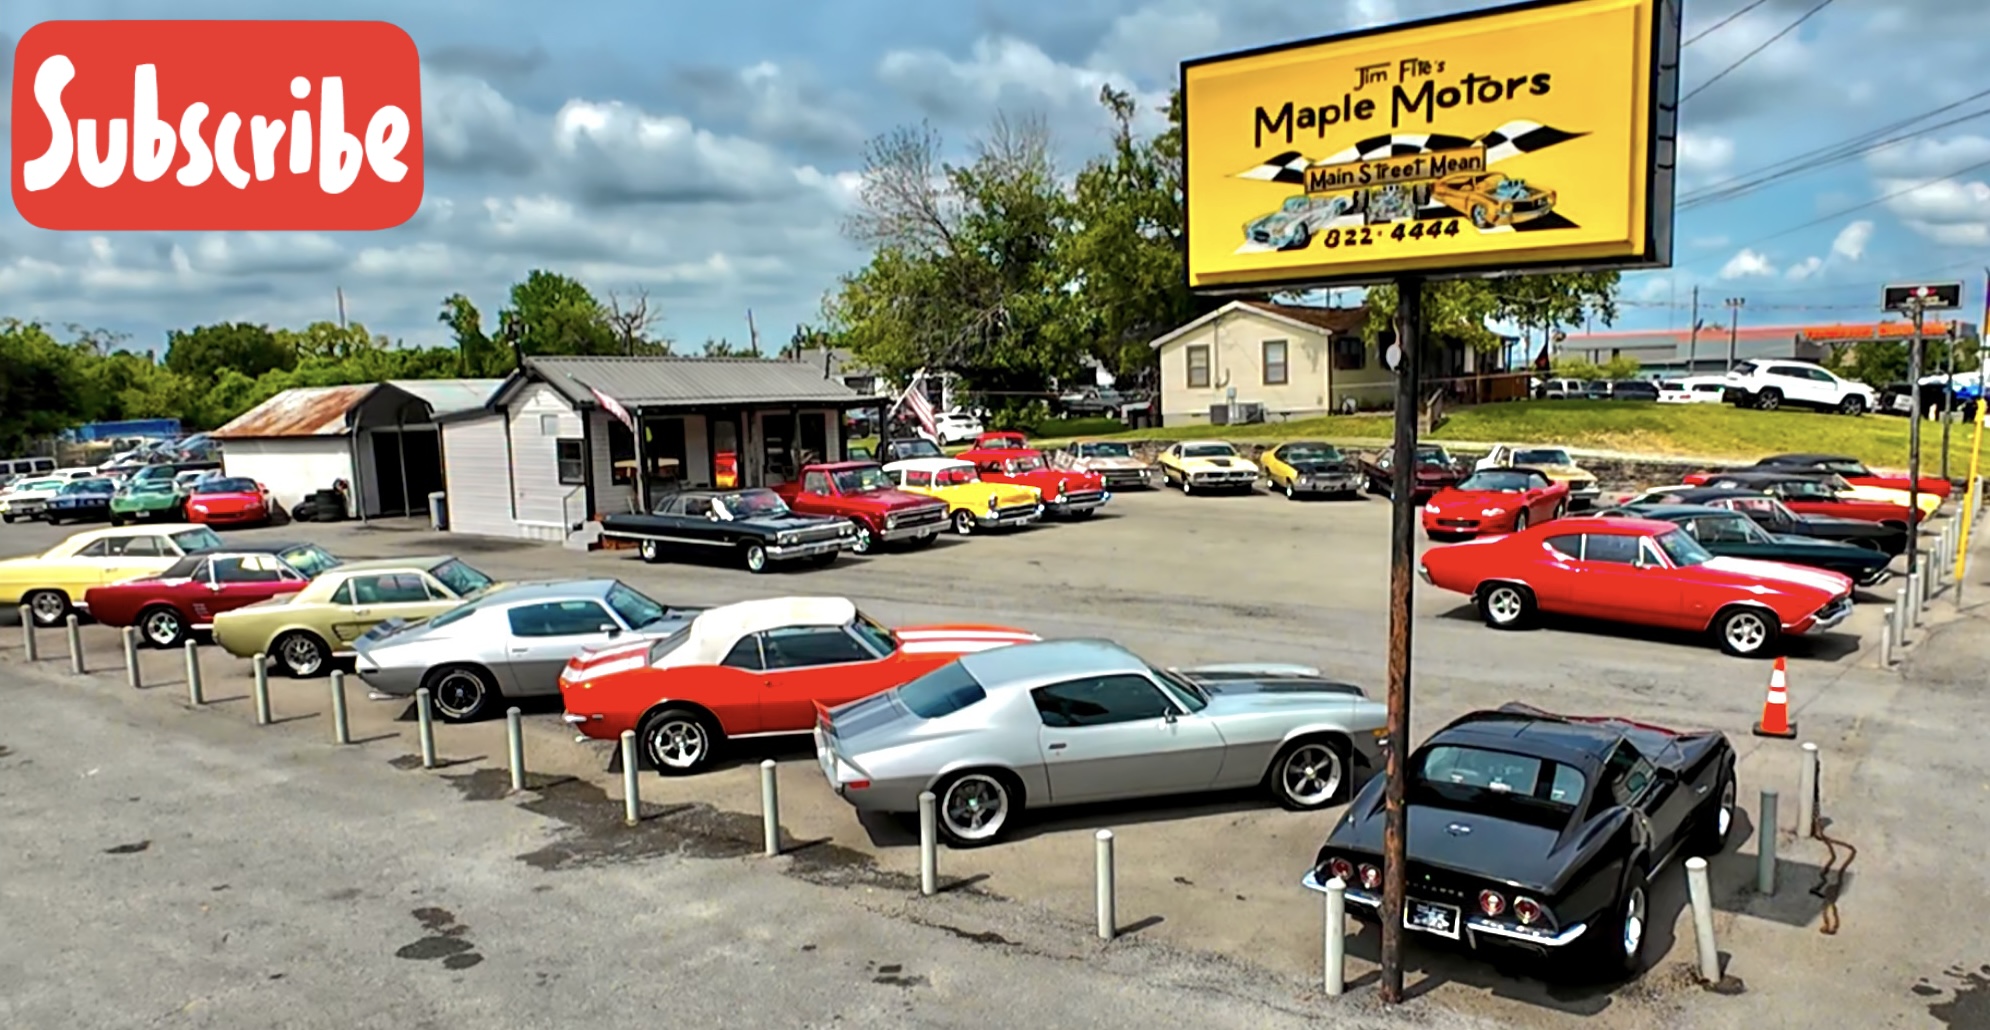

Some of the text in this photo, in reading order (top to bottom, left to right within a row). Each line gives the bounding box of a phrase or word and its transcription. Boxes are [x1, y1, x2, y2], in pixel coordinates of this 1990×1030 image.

[1353, 62, 1391, 91] Jim
[1254, 71, 1551, 148] Maple Motors
[1310, 153, 1482, 191] Main Street Mean
